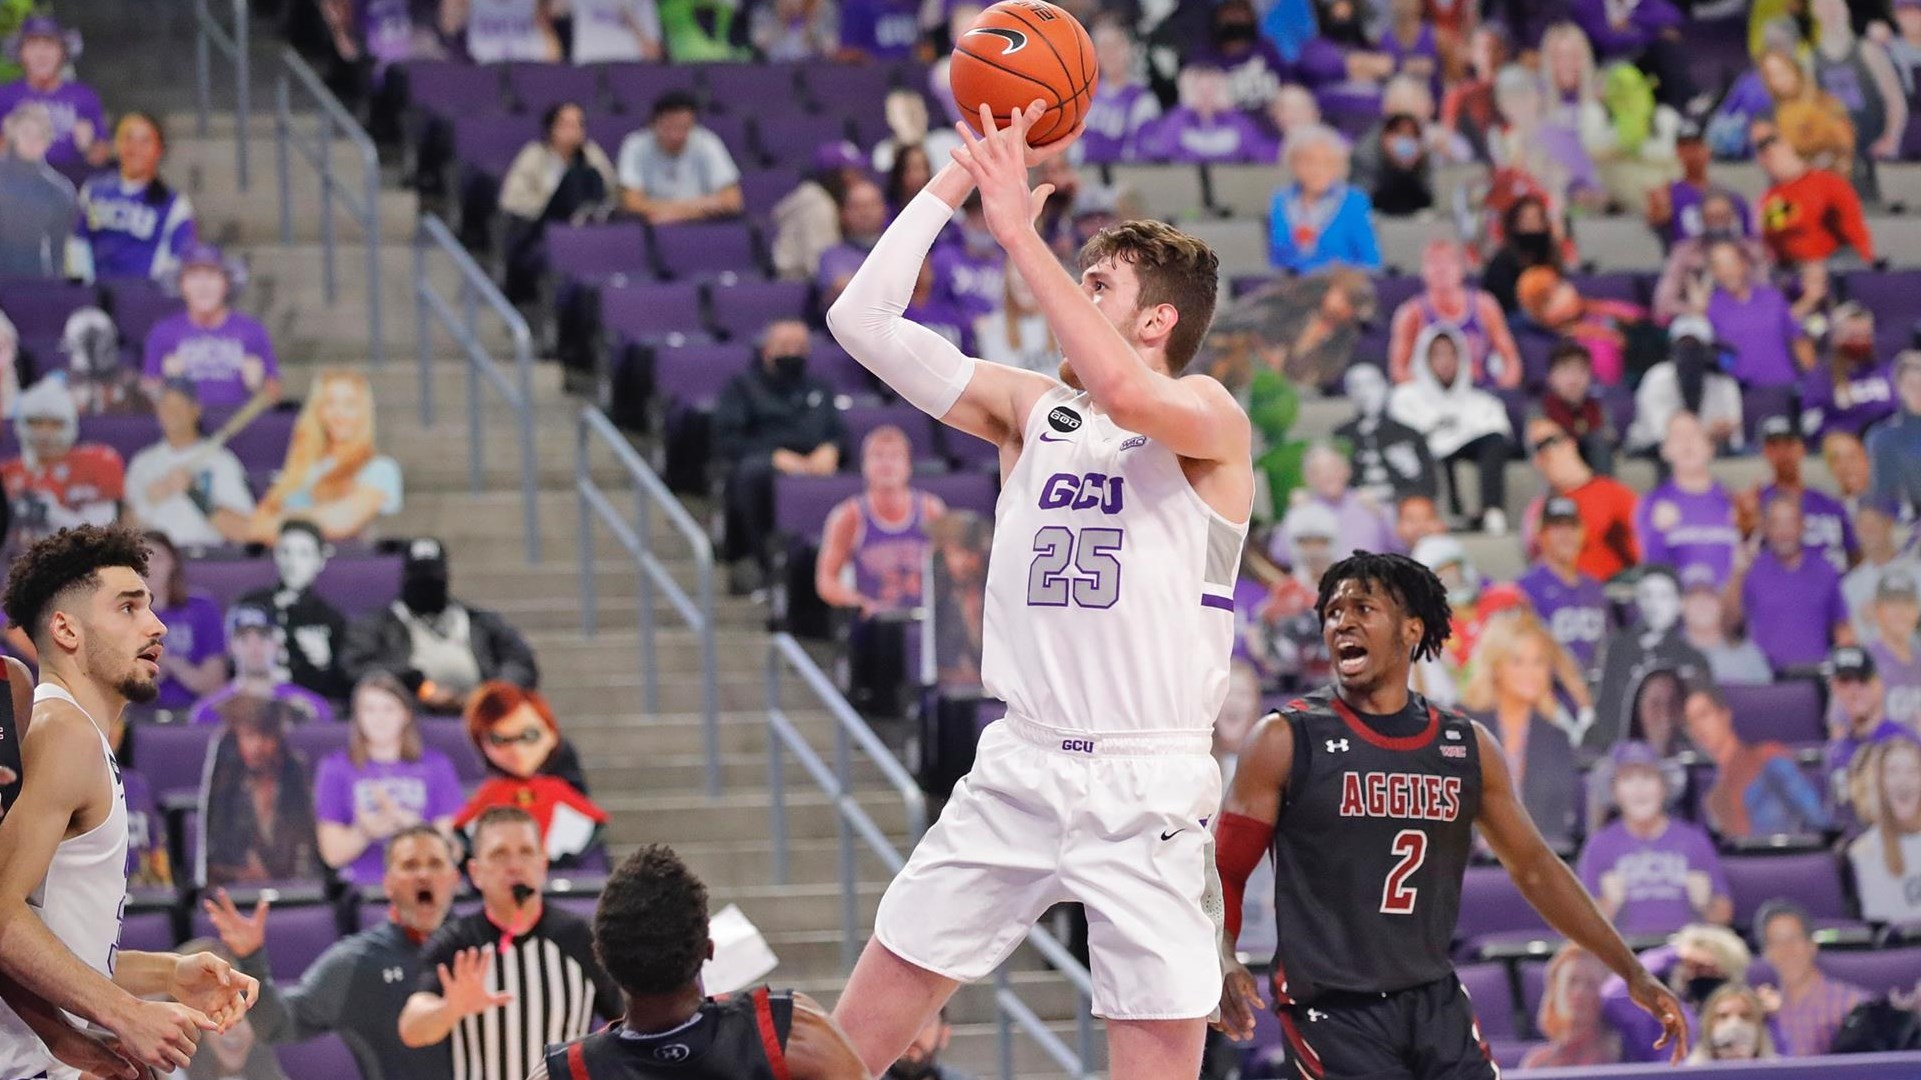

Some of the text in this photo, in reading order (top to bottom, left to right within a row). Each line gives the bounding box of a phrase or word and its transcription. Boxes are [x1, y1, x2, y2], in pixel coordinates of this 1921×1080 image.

[1038, 472, 1124, 515] GCU
[1027, 526, 1123, 609] 25
[1061, 739, 1094, 753] GCU
[1339, 771, 1462, 822] AGGIES
[1379, 829, 1428, 914] 2
